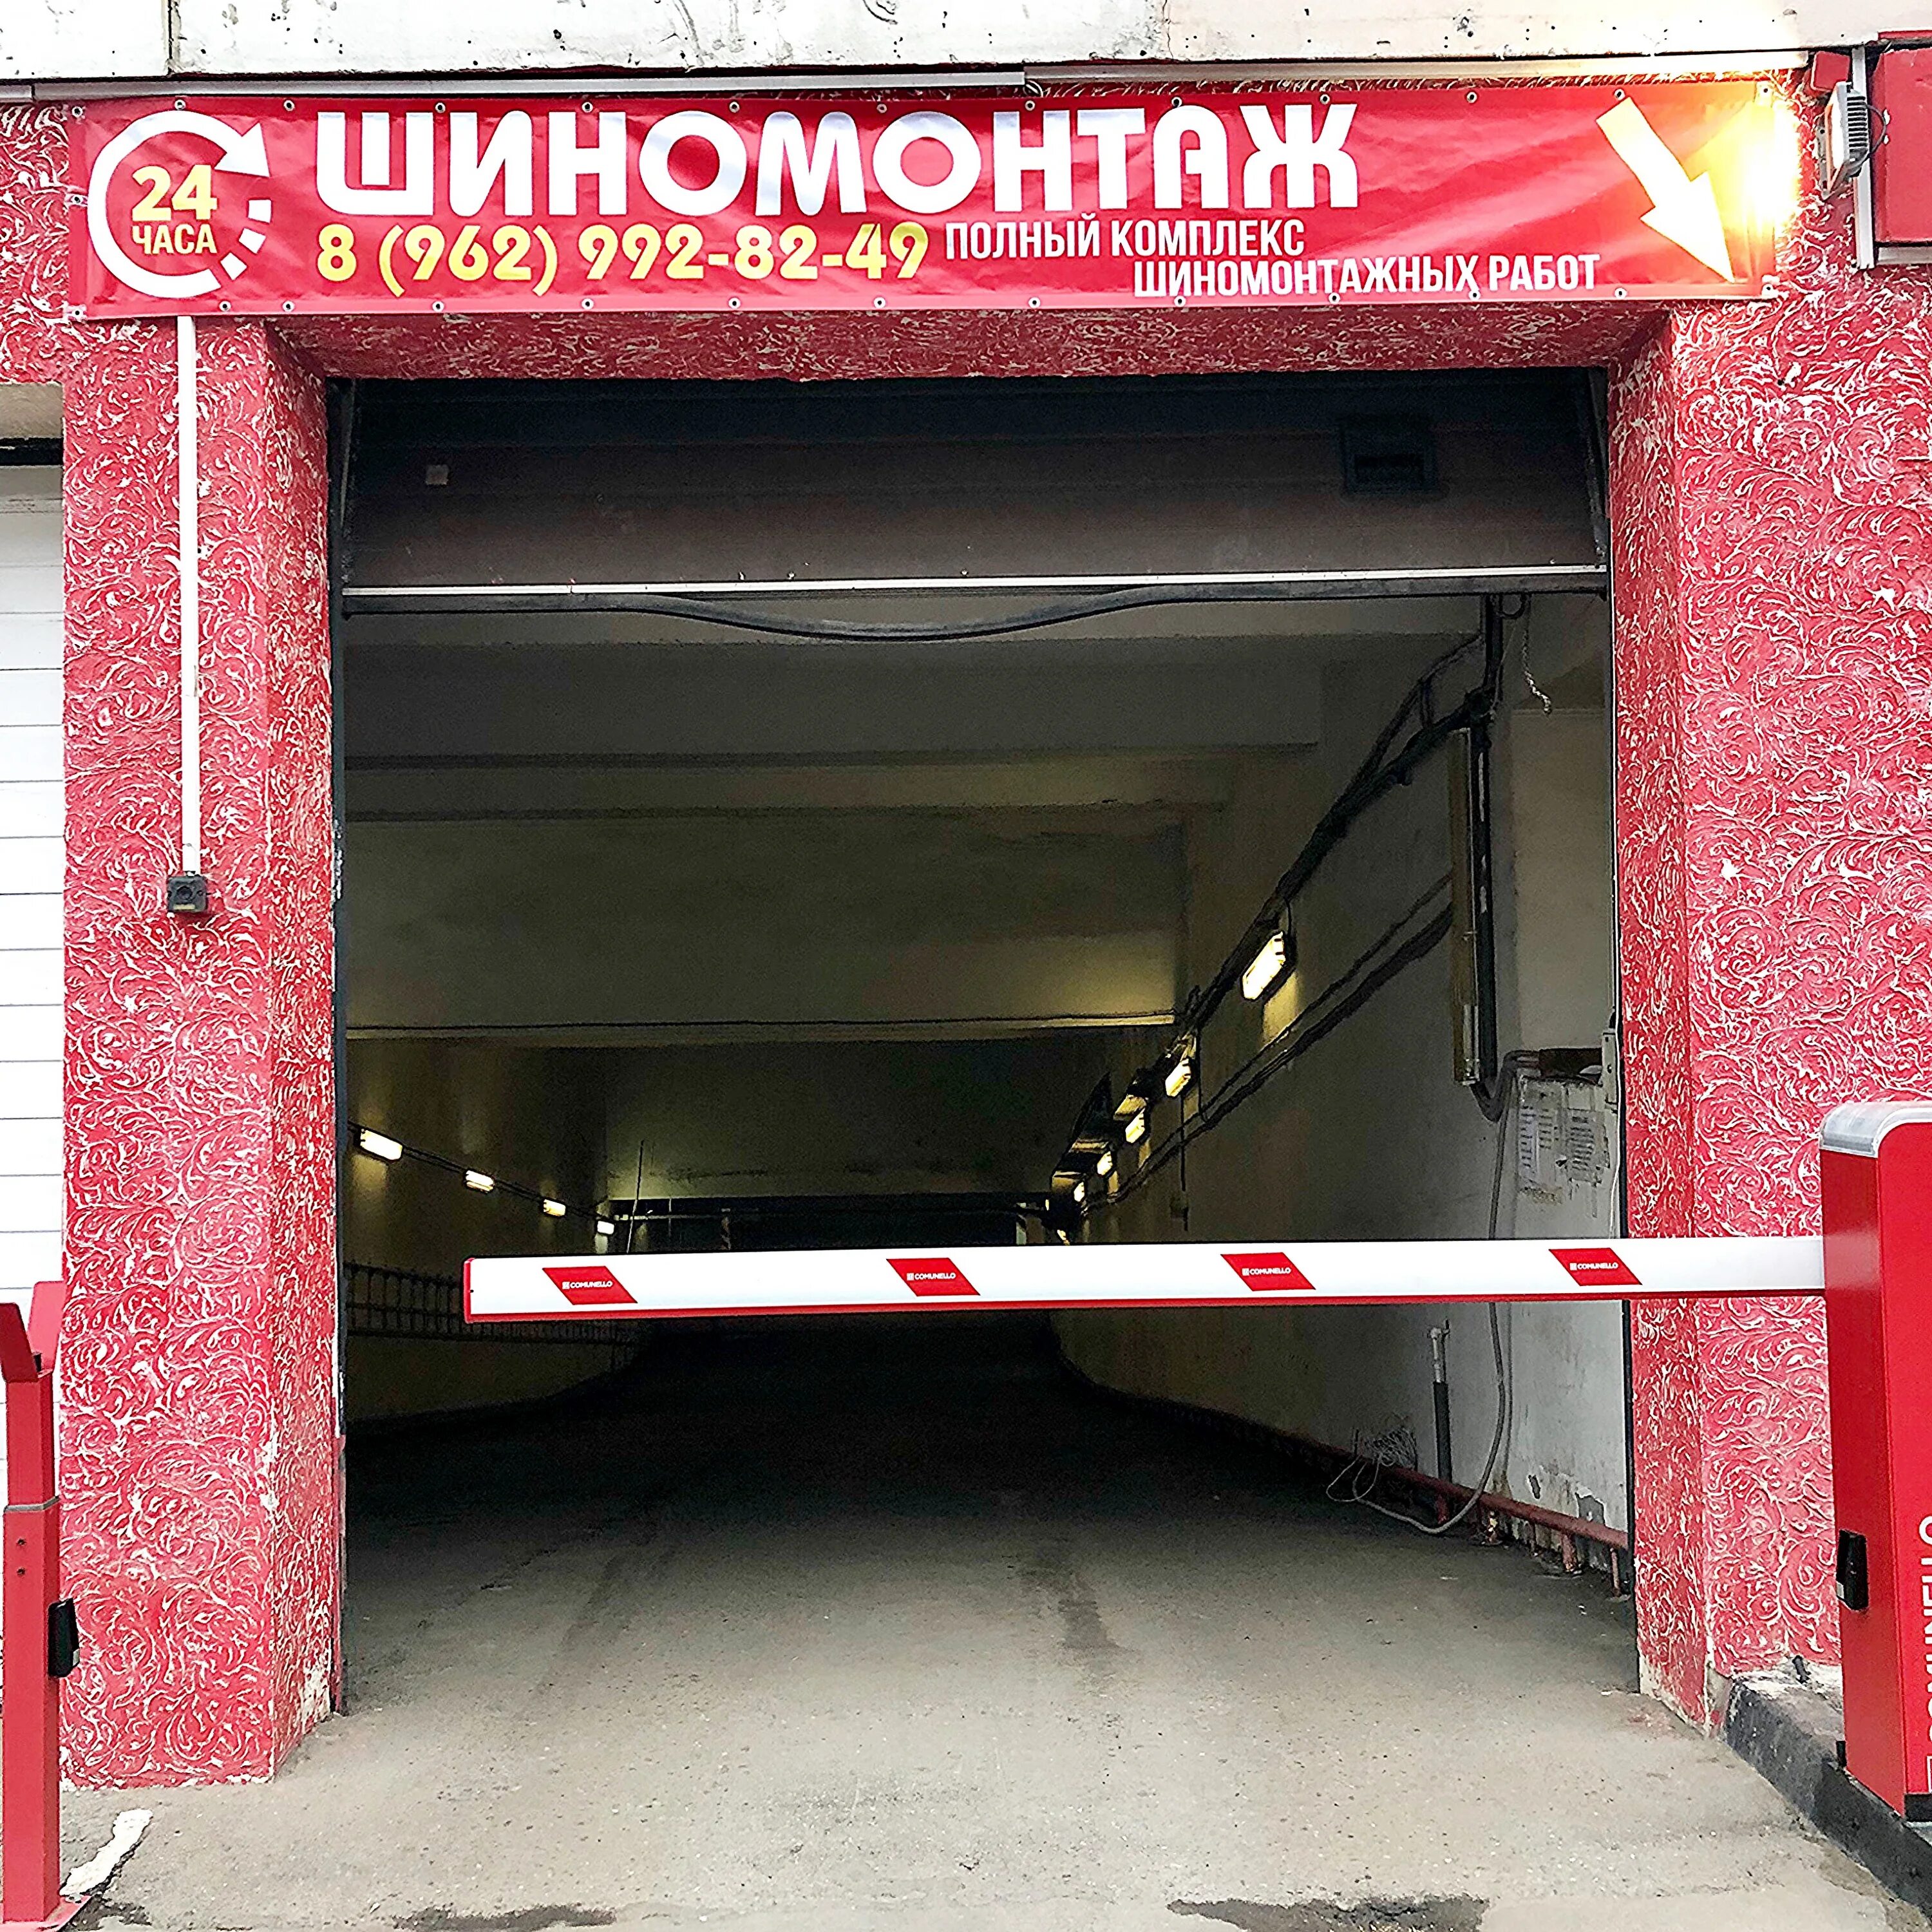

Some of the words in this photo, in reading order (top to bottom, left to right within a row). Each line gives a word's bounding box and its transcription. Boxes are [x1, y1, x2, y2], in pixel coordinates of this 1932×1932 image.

[317, 104, 1358, 216] ШИНОМОНТАЖ
[132, 162, 218, 222] 24
[132, 223, 218, 254] ЧАСА
[945, 213, 1100, 259] ПОЛНЫЙ
[1112, 219, 1304, 256] КОМПЛЕКС
[317, 223, 357, 281] 8
[379, 225, 558, 298] (962)
[578, 222, 929, 279] 992-82-49
[1133, 256, 1479, 298] ШИНОМОНТАЖНЫХ
[1489, 254, 1601, 292] РАБОТ
[569, 1280, 613, 1289] COMUNELLO
[914, 1272, 956, 1280] COMUNELLO
[1249, 1267, 1291, 1275] COMUNELLO
[1577, 1262, 1618, 1271] COMUNELLO
